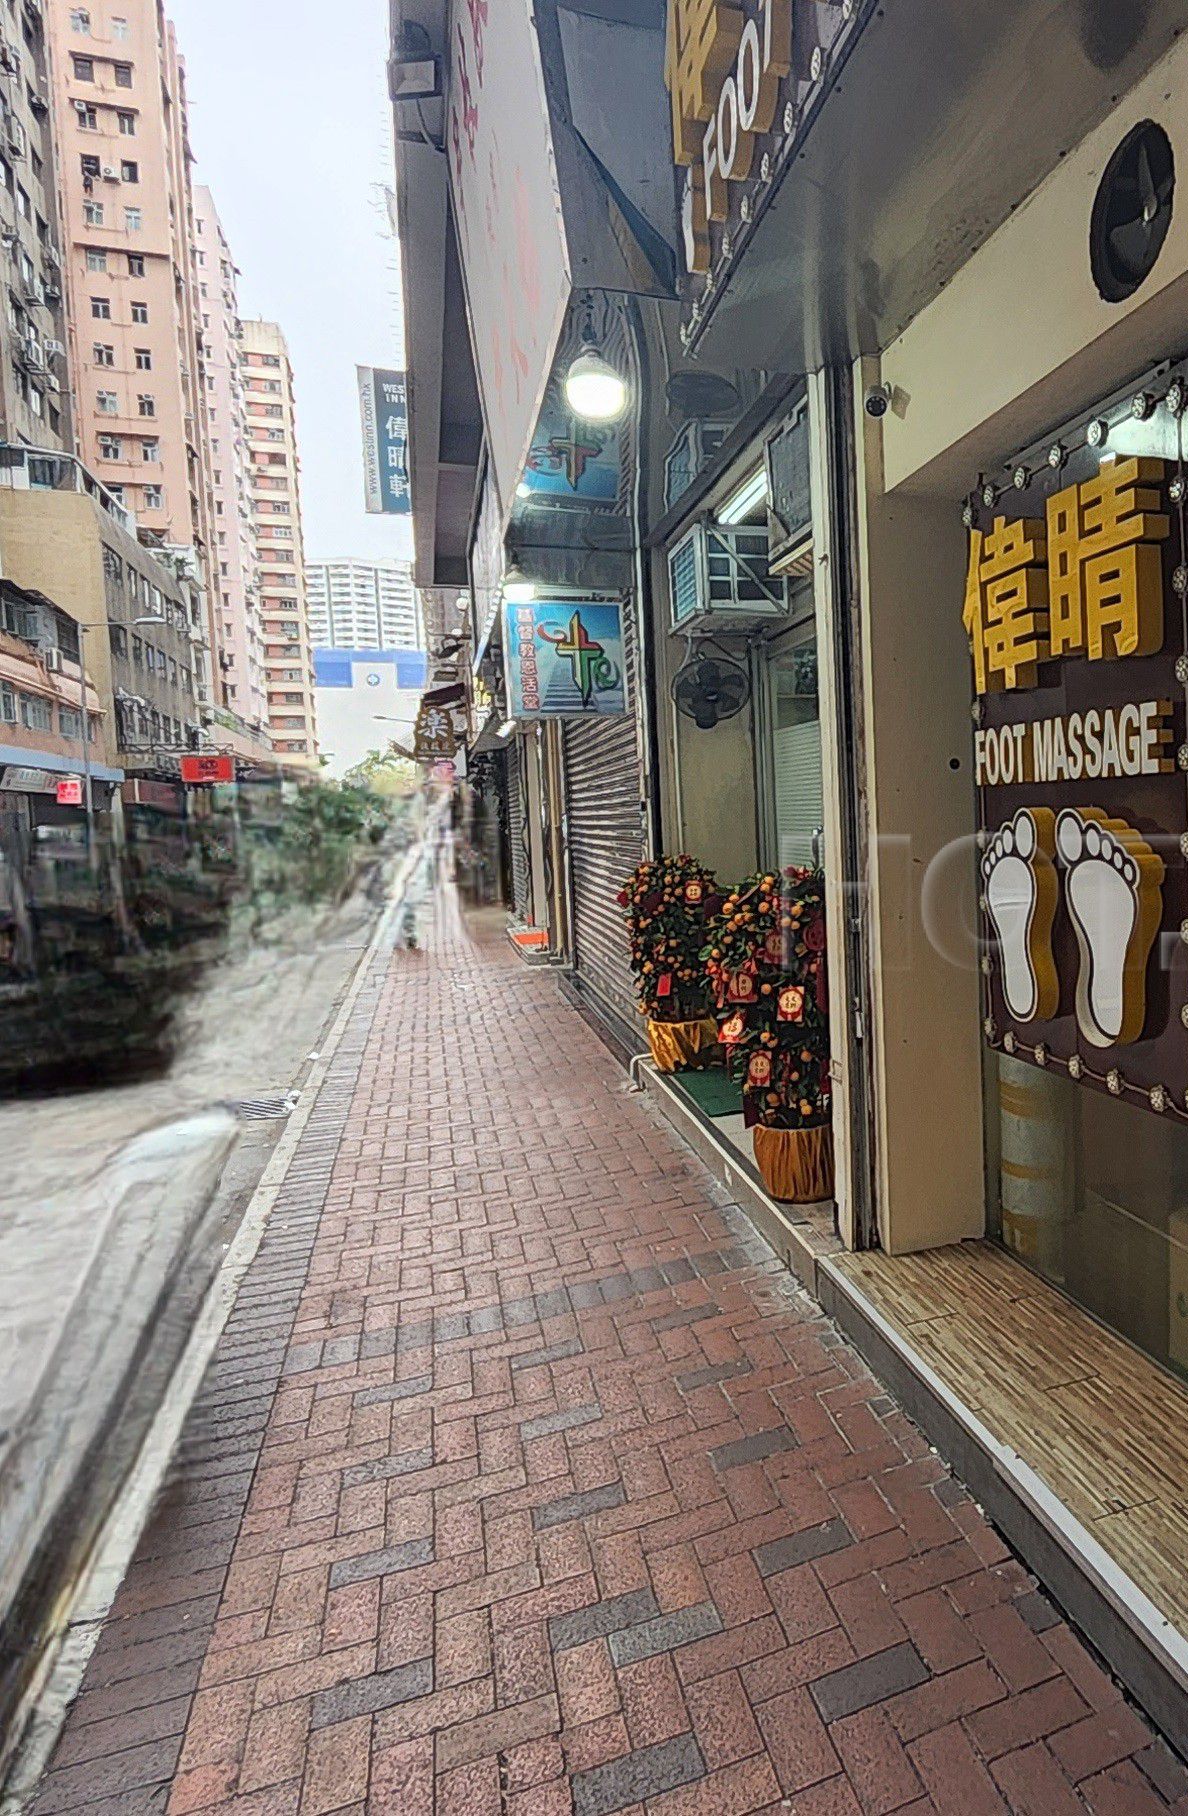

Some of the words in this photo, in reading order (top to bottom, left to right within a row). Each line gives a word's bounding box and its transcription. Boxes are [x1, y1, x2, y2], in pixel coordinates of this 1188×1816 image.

[383, 383, 405, 394] WES
[963, 452, 1152, 695] 偉晴
[974, 724, 1026, 787] FOOT
[1034, 700, 1163, 784] MASSAGE
